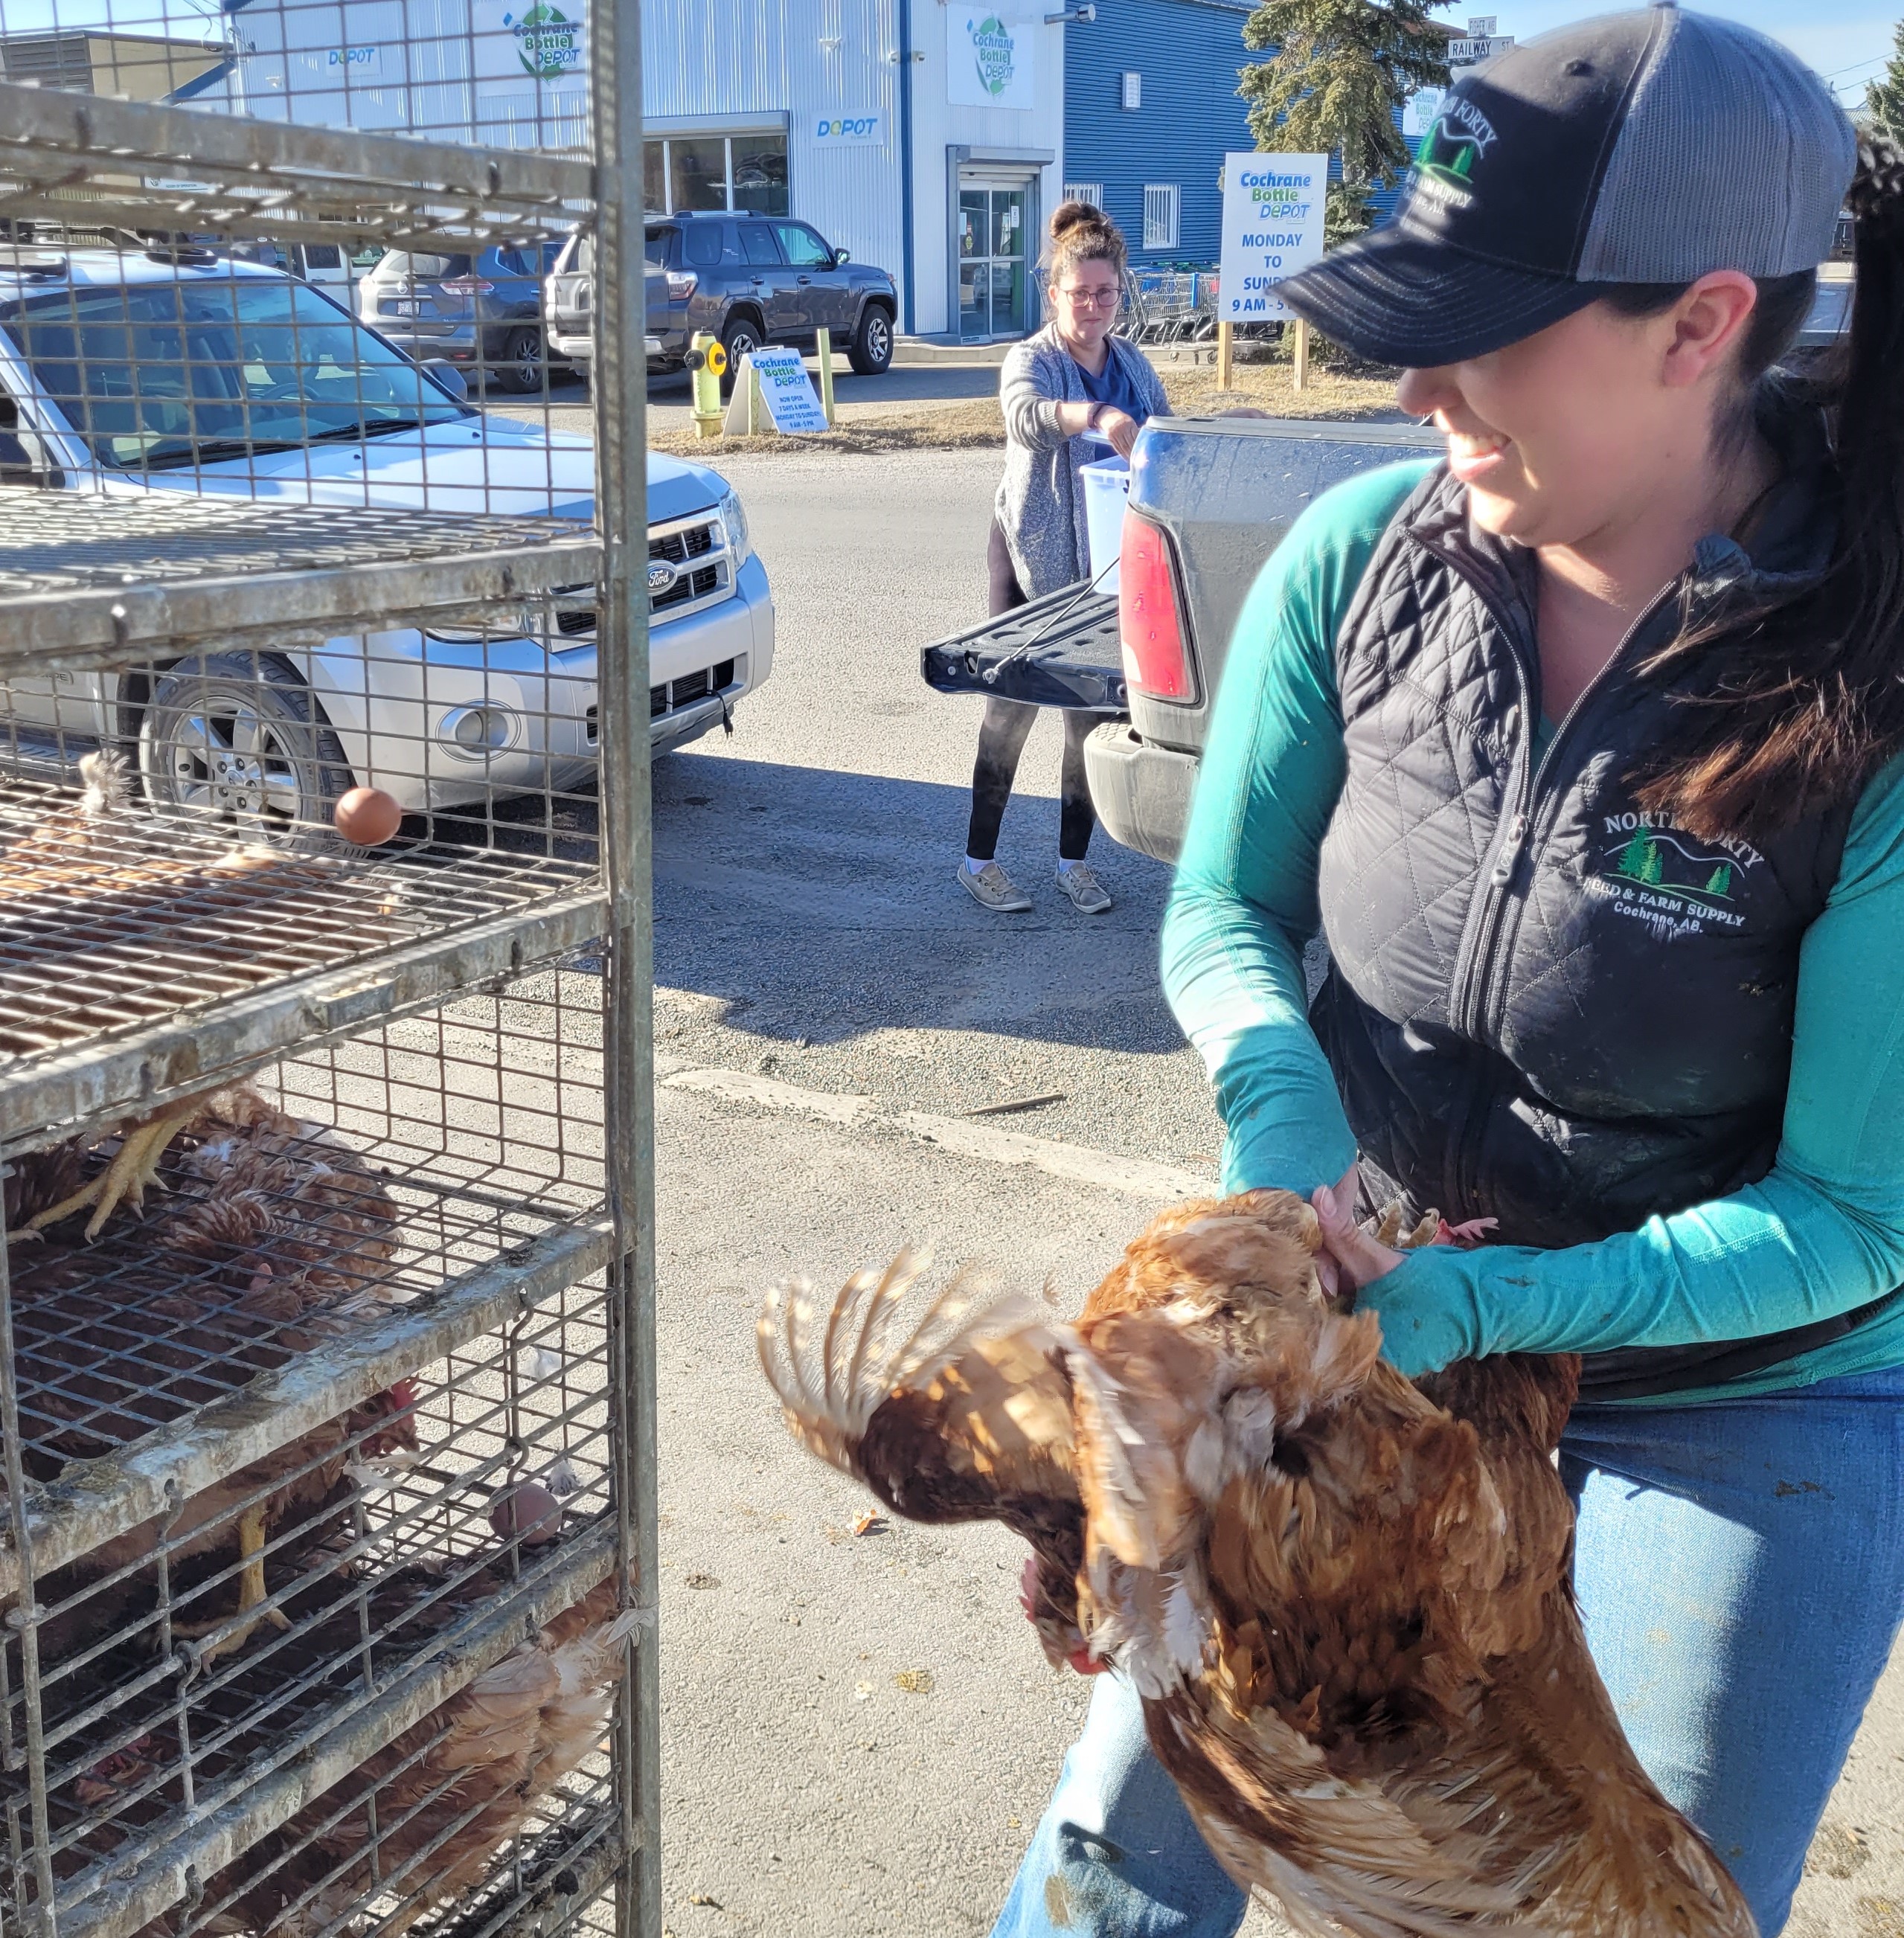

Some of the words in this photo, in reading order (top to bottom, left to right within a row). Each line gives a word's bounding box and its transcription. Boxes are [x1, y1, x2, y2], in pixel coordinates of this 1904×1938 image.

[513, 22, 579, 38] Cochrane
[525, 34, 568, 51] Bottle
[972, 31, 1015, 50] Cochrane
[1452, 40, 1492, 57] RAILWAY
[1501, 41, 1510, 51] ST
[980, 47, 1007, 63] Bottle
[1454, 99, 1498, 148] FORTY
[1240, 171, 1312, 188] Cochrane
[1251, 187, 1298, 202] Bottle
[1242, 234, 1303, 248] MONDAY
[1264, 255, 1282, 269] TO
[1232, 299, 1240, 312] 9
[1243, 298, 1266, 312] AM
[1276, 299, 1284, 311] 5
[753, 358, 801, 368] Cochrane
[764, 368, 796, 378] Bottle
[648, 569, 670, 587] Ford
[1623, 888, 1635, 901] &
[1638, 891, 1683, 912] FARM
[1687, 903, 1746, 927] SUPPLY
